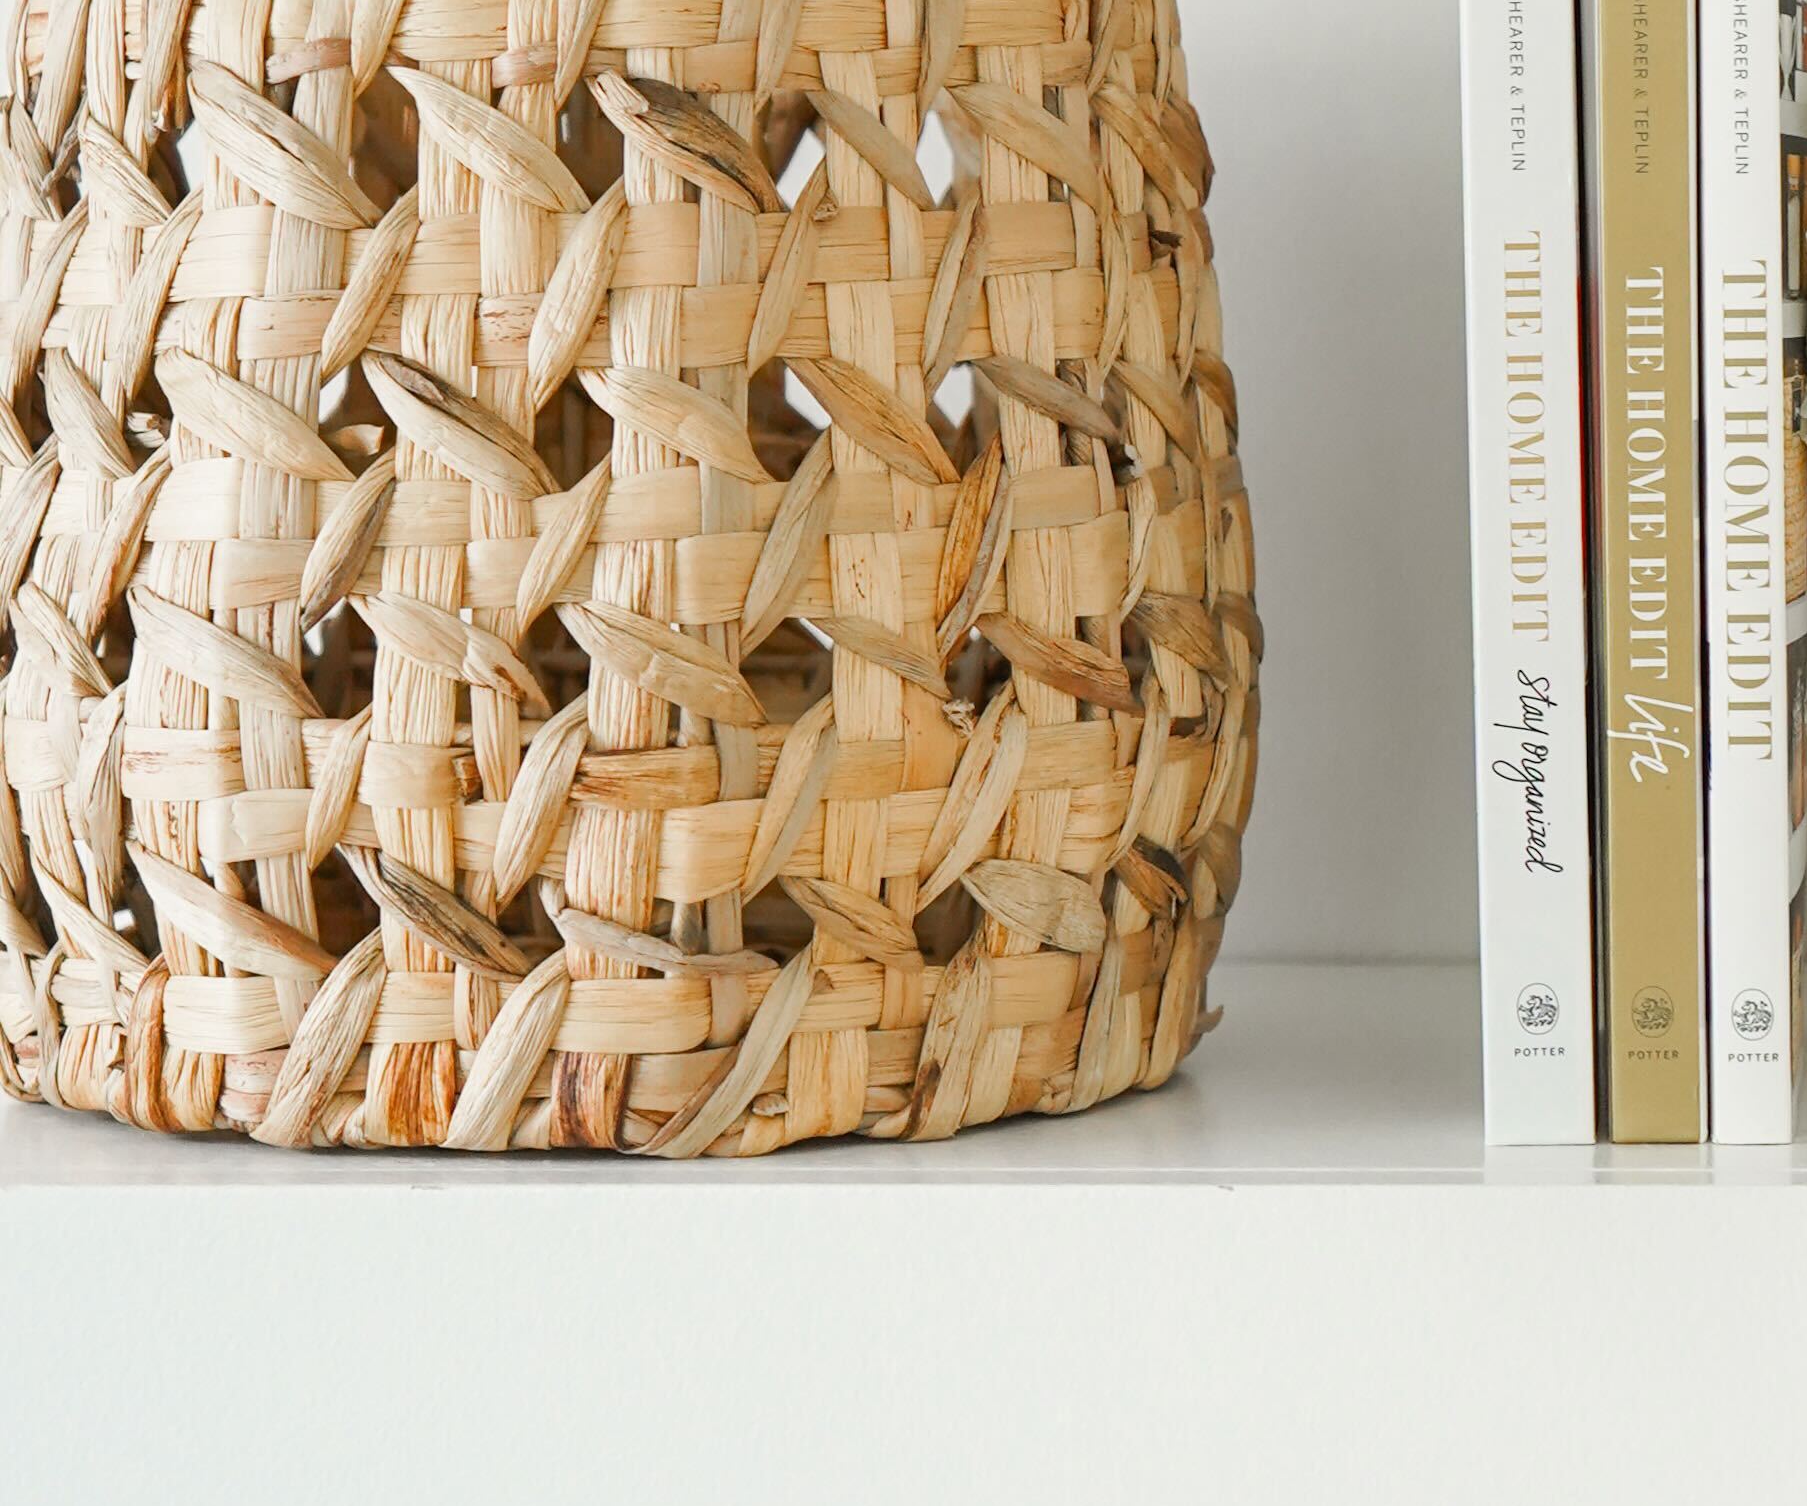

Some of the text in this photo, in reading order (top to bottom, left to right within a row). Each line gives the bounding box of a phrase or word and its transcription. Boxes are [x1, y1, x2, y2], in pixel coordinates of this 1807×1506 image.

[1505, 351, 1551, 644] HOME EDIT
[1626, 388, 1670, 682] HOME EDIT
[1723, 406, 1775, 761] HOME EDIT
[1492, 740, 1564, 874] organized
[1513, 1045, 1566, 1058] POTTER
[1627, 1049, 1680, 1062] POTTER
[1727, 1051, 1780, 1064] POTTER
